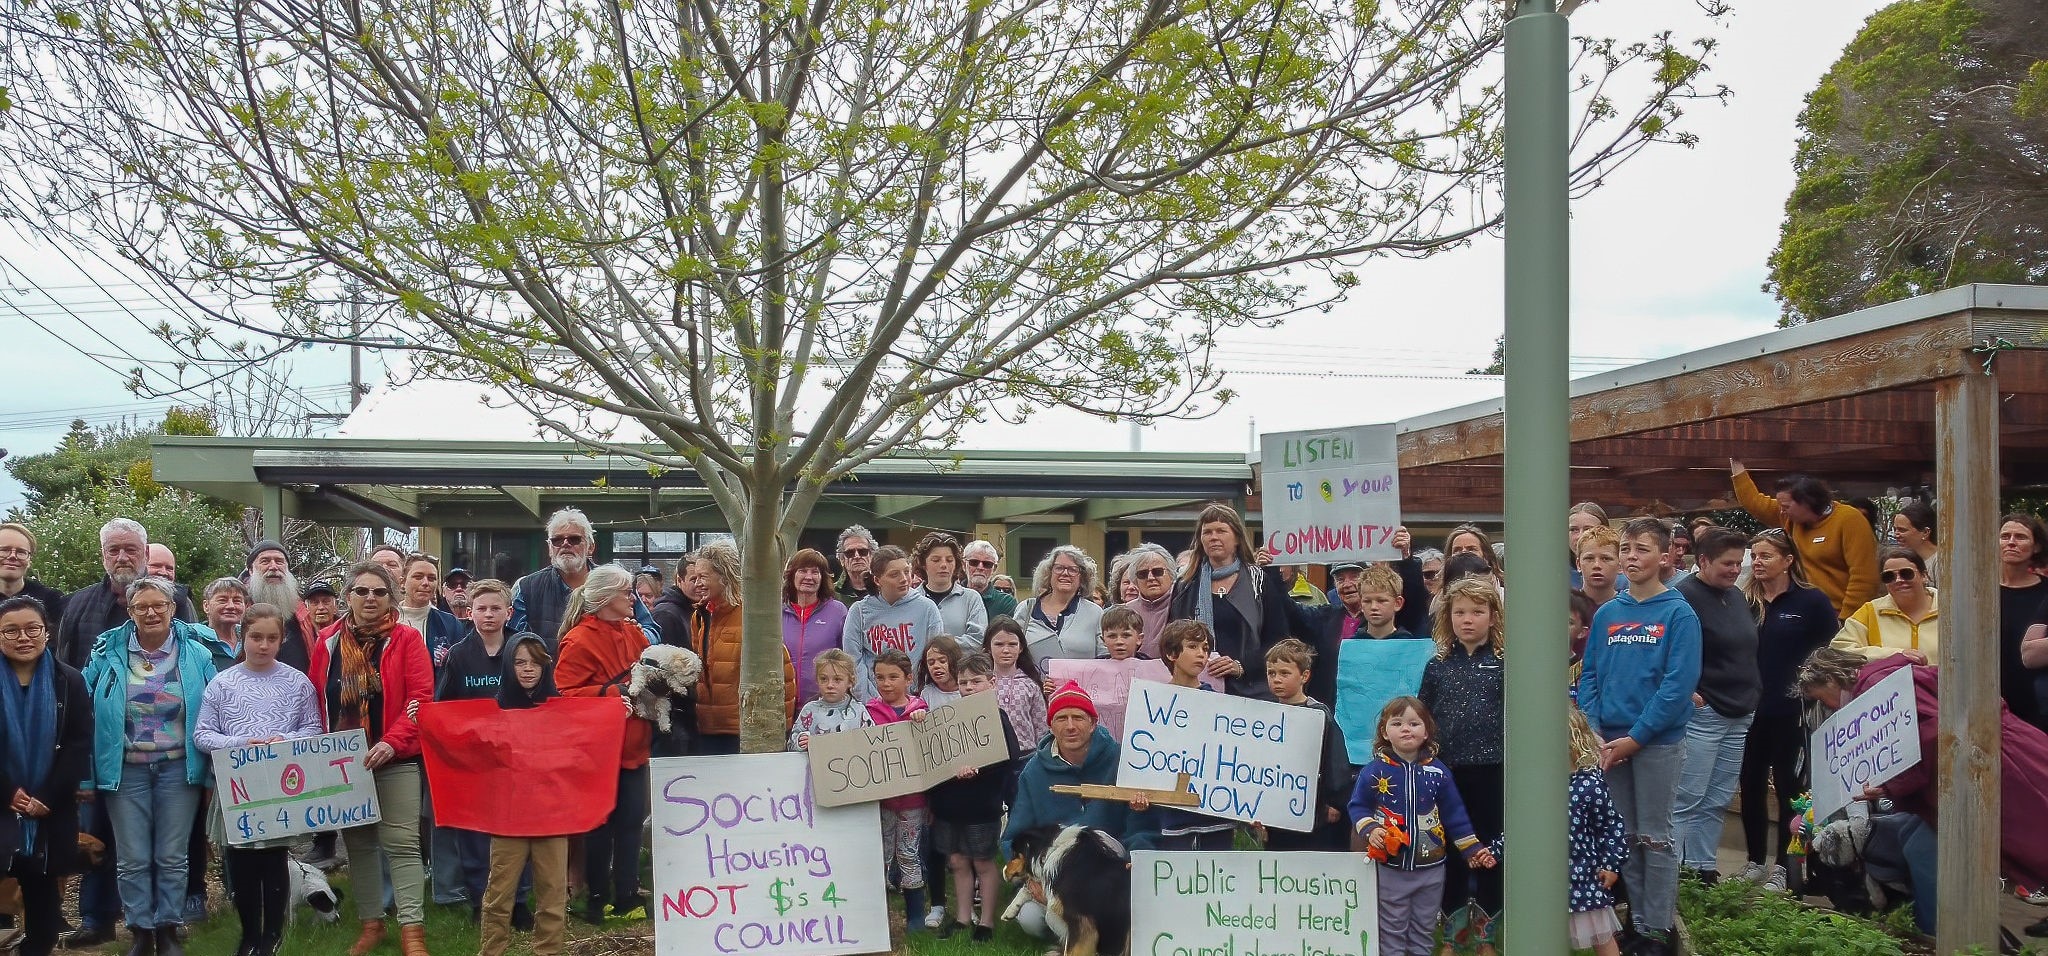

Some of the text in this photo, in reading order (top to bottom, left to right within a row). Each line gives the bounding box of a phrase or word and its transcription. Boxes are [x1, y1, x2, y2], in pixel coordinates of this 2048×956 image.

[1283, 437, 1354, 468] LISTEN
[1286, 474, 1393, 501] TO YOUR
[1268, 524, 1393, 556] COMMUNITY
[1608, 634, 1657, 646] patagonia
[465, 676, 502, 687] Hurley
[863, 705, 956, 746] WE NEED
[1143, 689, 1188, 729] We
[1214, 711, 1285, 743] need
[1825, 691, 1899, 761] Hear our
[229, 734, 360, 769] SOCIAL HOUSING
[827, 715, 991, 792] SOCIAL HOUSING
[1841, 739, 1903, 793] VOICE
[1128, 730, 1308, 817] Social Housing
[276, 808, 290, 829] 4
[305, 798, 376, 828] COUNCIL
[663, 763, 813, 836] Social
[705, 833, 832, 878] Housing
[662, 877, 847, 921] NOT $'s 4
[1154, 859, 1358, 909] Public Housing
[714, 915, 859, 953] COUNCIL
[1206, 901, 1350, 935] Needed Here!
